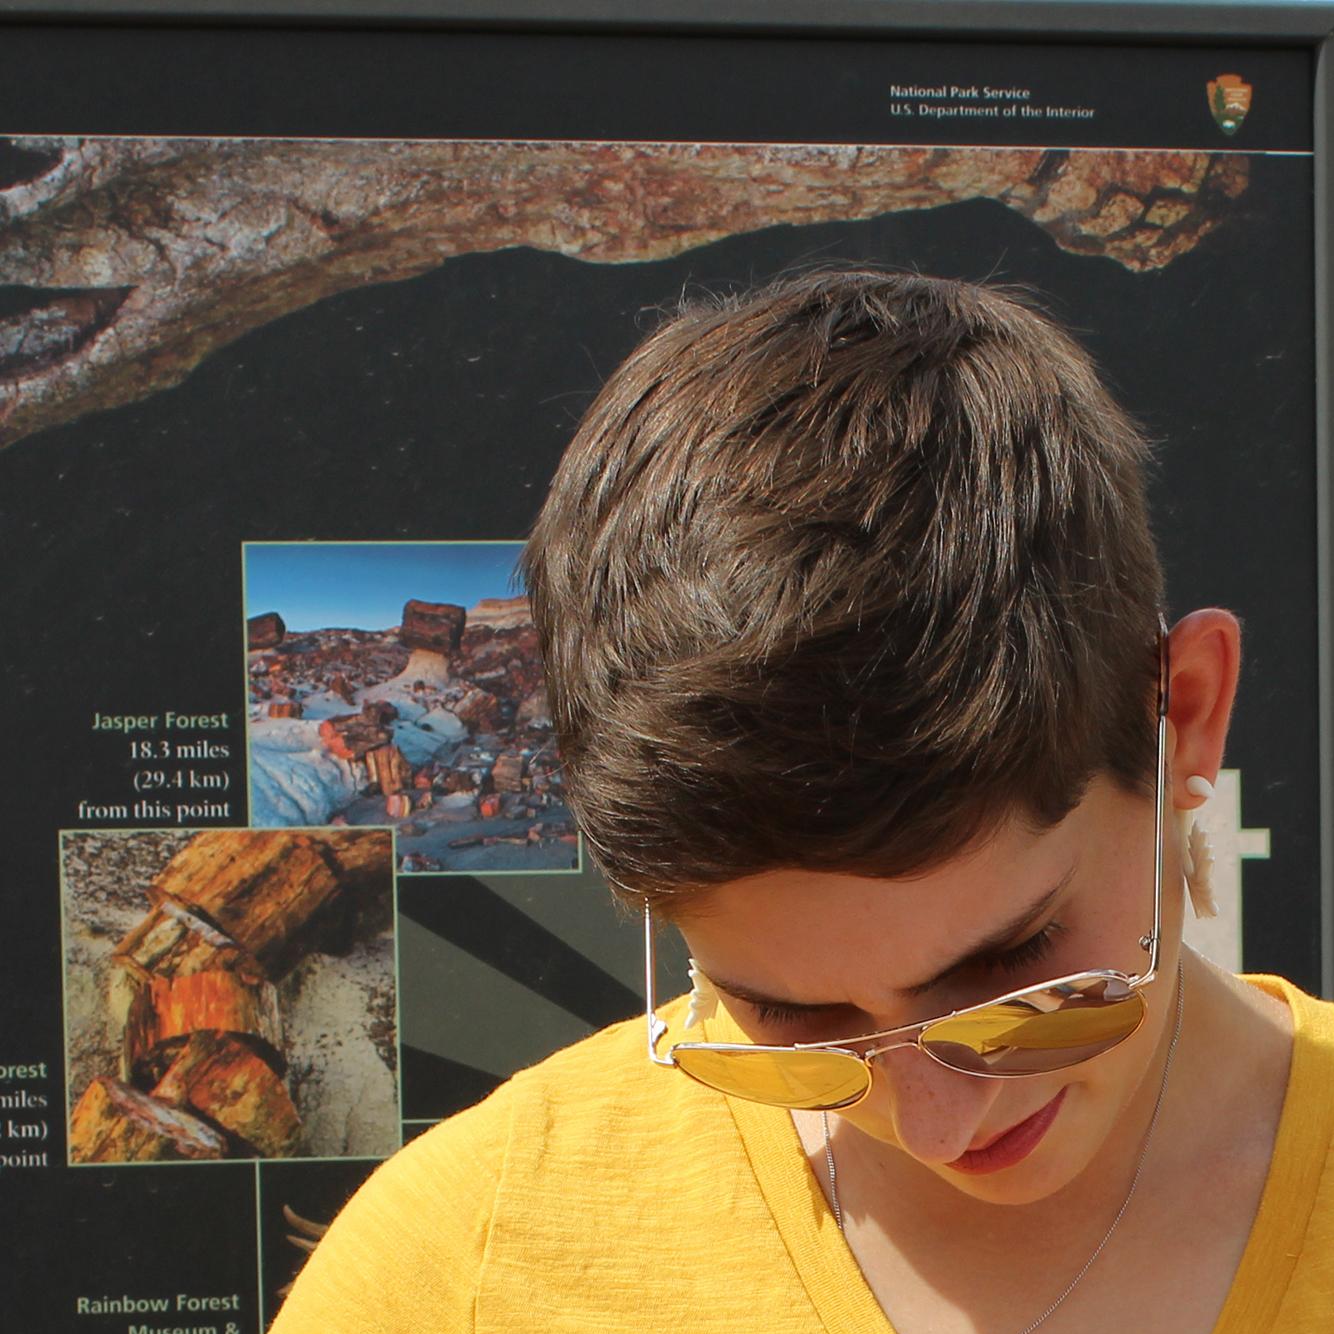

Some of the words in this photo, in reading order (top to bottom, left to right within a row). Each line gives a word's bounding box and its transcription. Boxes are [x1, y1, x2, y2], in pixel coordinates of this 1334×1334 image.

[890, 85, 947, 98] National
[950, 86, 979, 99] Park
[983, 86, 1031, 100] Service
[890, 103, 915, 116] U.S.
[919, 104, 999, 119] Department
[1003, 104, 1017, 117] of
[1021, 105, 1042, 118] the
[1046, 105, 1095, 118] Interior
[92, 712, 158, 734] Jasper
[165, 711, 229, 730] Forest
[130, 741, 170, 759] 18.3
[176, 740, 230, 758] miles
[133, 770, 183, 792] (29.4
[189, 770, 230, 791] km)
[78, 801, 128, 819] from
[134, 801, 171, 818] this
[177, 801, 230, 823] point
[0, 1061, 48, 1079] orest
[8, 1120, 48, 1141] km)
[76, 1294, 168, 1315] Rainbow
[176, 1294, 240, 1312] Forest
